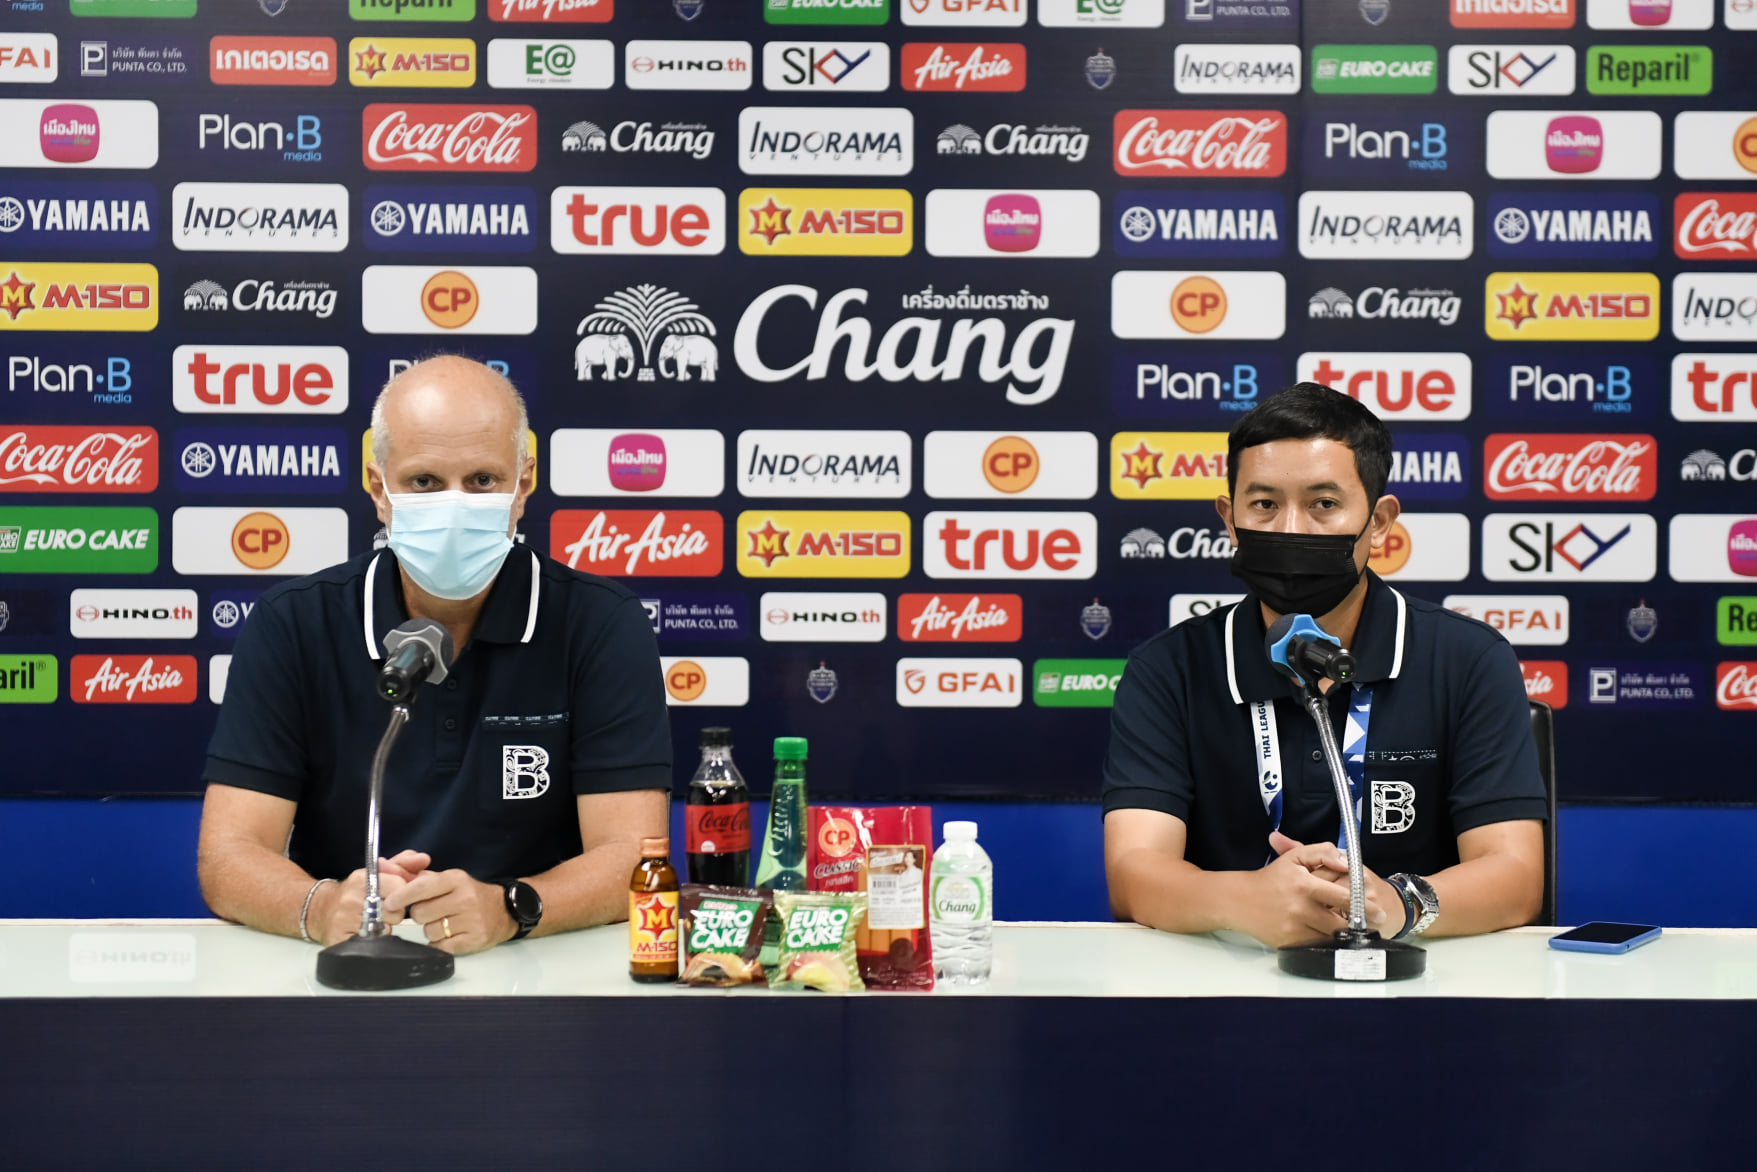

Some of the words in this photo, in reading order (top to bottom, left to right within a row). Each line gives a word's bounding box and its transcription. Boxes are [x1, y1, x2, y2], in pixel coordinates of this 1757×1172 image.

[112, 62, 143, 72] PUNTA
[782, 47, 871, 85] SKY
[1340, 61, 1388, 78] EURO
[1388, 60, 1434, 77] CAKE
[1467, 51, 1557, 88] SKY
[367, 111, 532, 166] Coca-Cola
[609, 120, 715, 160] Chang
[749, 121, 902, 154] INDORAMA
[984, 123, 1090, 162] Chang
[1118, 117, 1281, 170] Coca-Cola
[284, 150, 322, 162] media
[1409, 159, 1448, 171] media
[27, 199, 150, 232] YAMAHA
[183, 197, 339, 230] INDORAMA
[407, 203, 530, 236] YAMAHA
[566, 194, 711, 248] true
[798, 208, 905, 236] M-150
[1156, 208, 1279, 241] YAMAHA
[1309, 206, 1463, 238] INDORAMA
[1530, 210, 1653, 242] YAMAHA
[42, 283, 151, 310] M-150
[231, 279, 338, 318] Chang
[427, 286, 472, 313] CP
[902, 284, 1050, 310] เครื่องดื่มตราช้าง
[1176, 292, 1221, 318] CP
[1356, 286, 1462, 326] Chang
[1544, 294, 1651, 319] M-150
[733, 284, 1076, 406] Chang
[187, 353, 334, 406] true
[93, 392, 132, 404] media
[1593, 401, 1632, 413] media
[218, 445, 341, 477] YAMAHA
[748, 444, 901, 476] INDORAMA
[988, 452, 1033, 478] CP
[1488, 441, 1651, 494] Coca-Cola
[23, 528, 86, 551] EURO
[88, 528, 150, 551] CAKE
[238, 528, 283, 554] CP
[796, 531, 902, 557] M-150
[938, 518, 1082, 572] true
[1167, 527, 1232, 559] Cha
[1508, 521, 1632, 573] SKY
[665, 619, 697, 629] PUNTA
[670, 672, 701, 690] CP
[938, 671, 1015, 694] GFAI
[1061, 674, 1110, 692] EURO
[1262, 734, 1272, 760] THAI
[502, 744, 551, 800] B
[1371, 780, 1416, 834] B
[823, 829, 851, 846] CP
[694, 909, 754, 930] EURO
[789, 908, 849, 930] EURO
[938, 899, 976, 914] Chang
[690, 928, 750, 949] CAKE
[786, 926, 843, 949] CAKE
